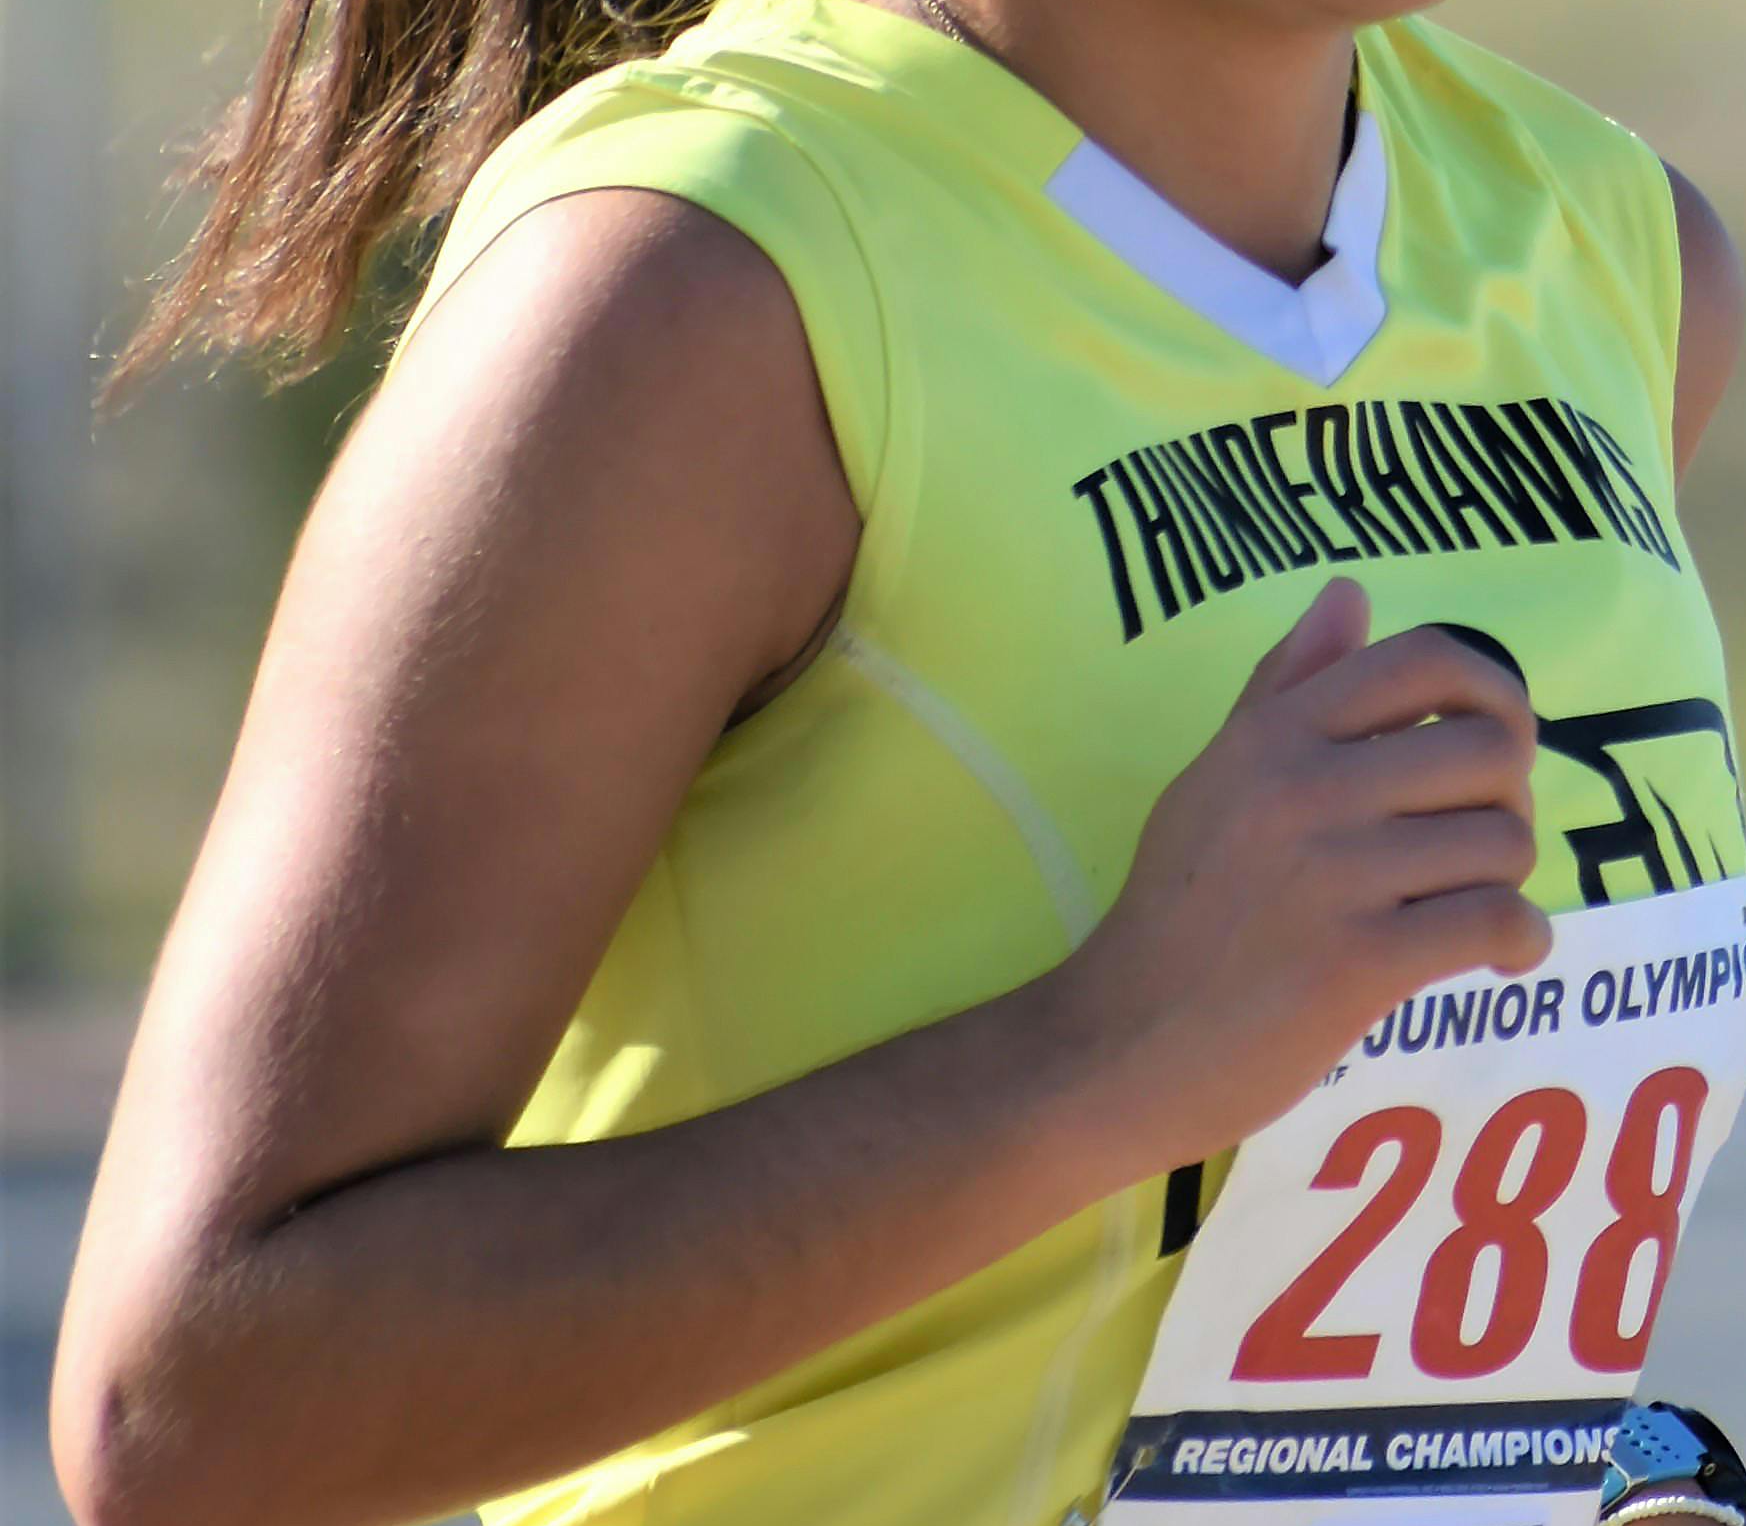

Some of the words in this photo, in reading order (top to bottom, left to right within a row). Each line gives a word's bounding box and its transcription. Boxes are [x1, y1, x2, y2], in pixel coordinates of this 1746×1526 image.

[1072, 397, 1682, 644] THUNDERHAWKS
[1363, 977, 1565, 1058] JUNIOR
[1229, 1066, 1709, 1381] 288
[1172, 1435, 1374, 1474] REGIONAL
